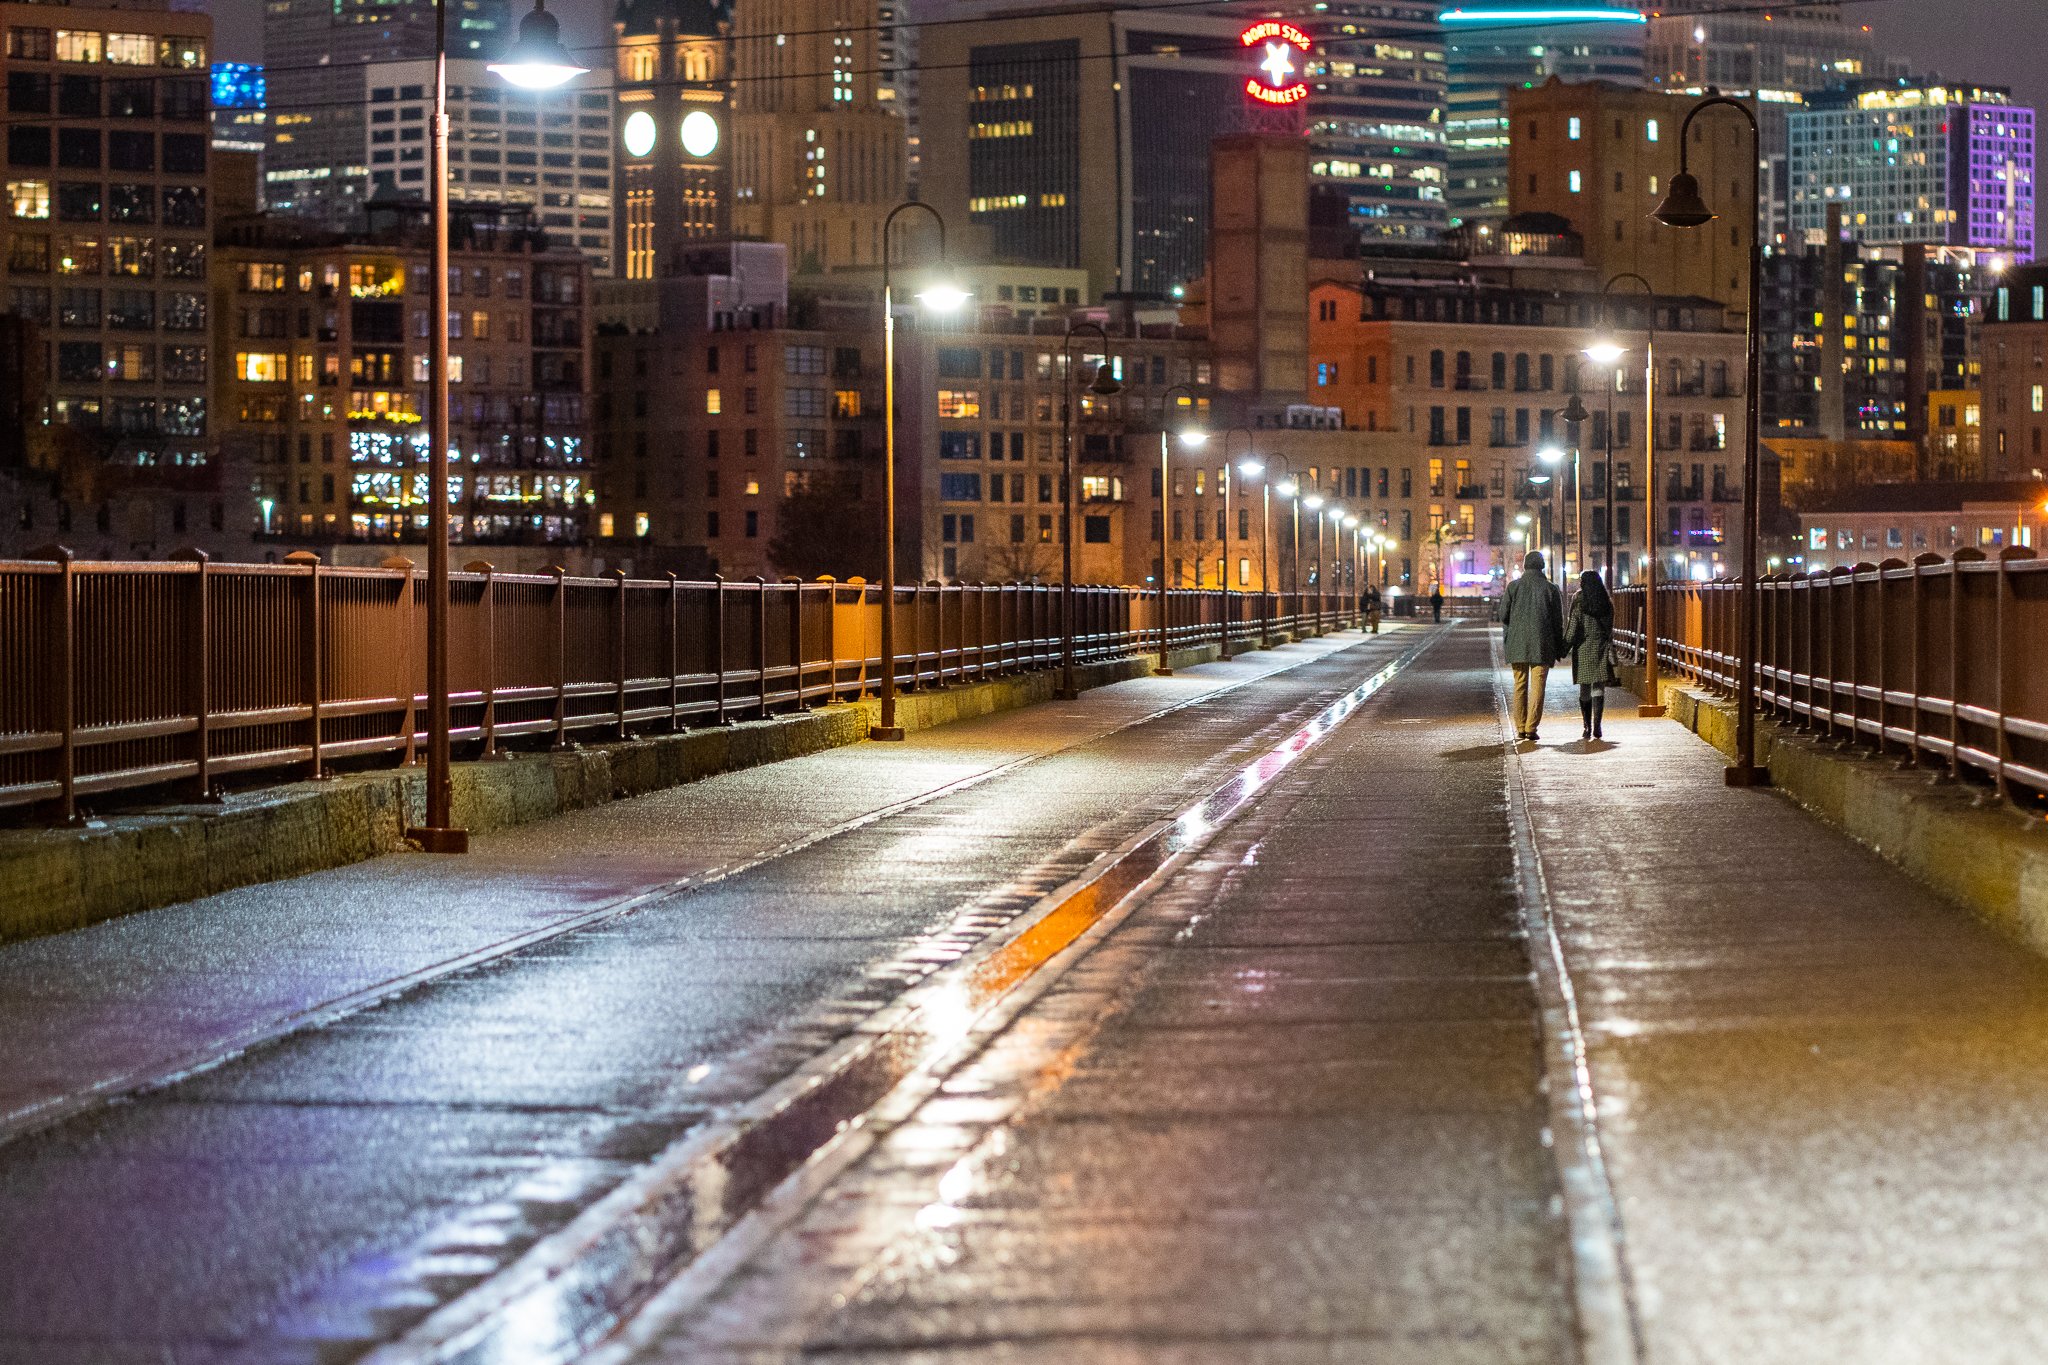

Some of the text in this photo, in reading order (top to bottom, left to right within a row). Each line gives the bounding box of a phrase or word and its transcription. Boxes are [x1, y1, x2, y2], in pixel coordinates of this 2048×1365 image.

[1242, 23, 1310, 51] NORTH STAR
[1247, 80, 1307, 104] BLANKETS
